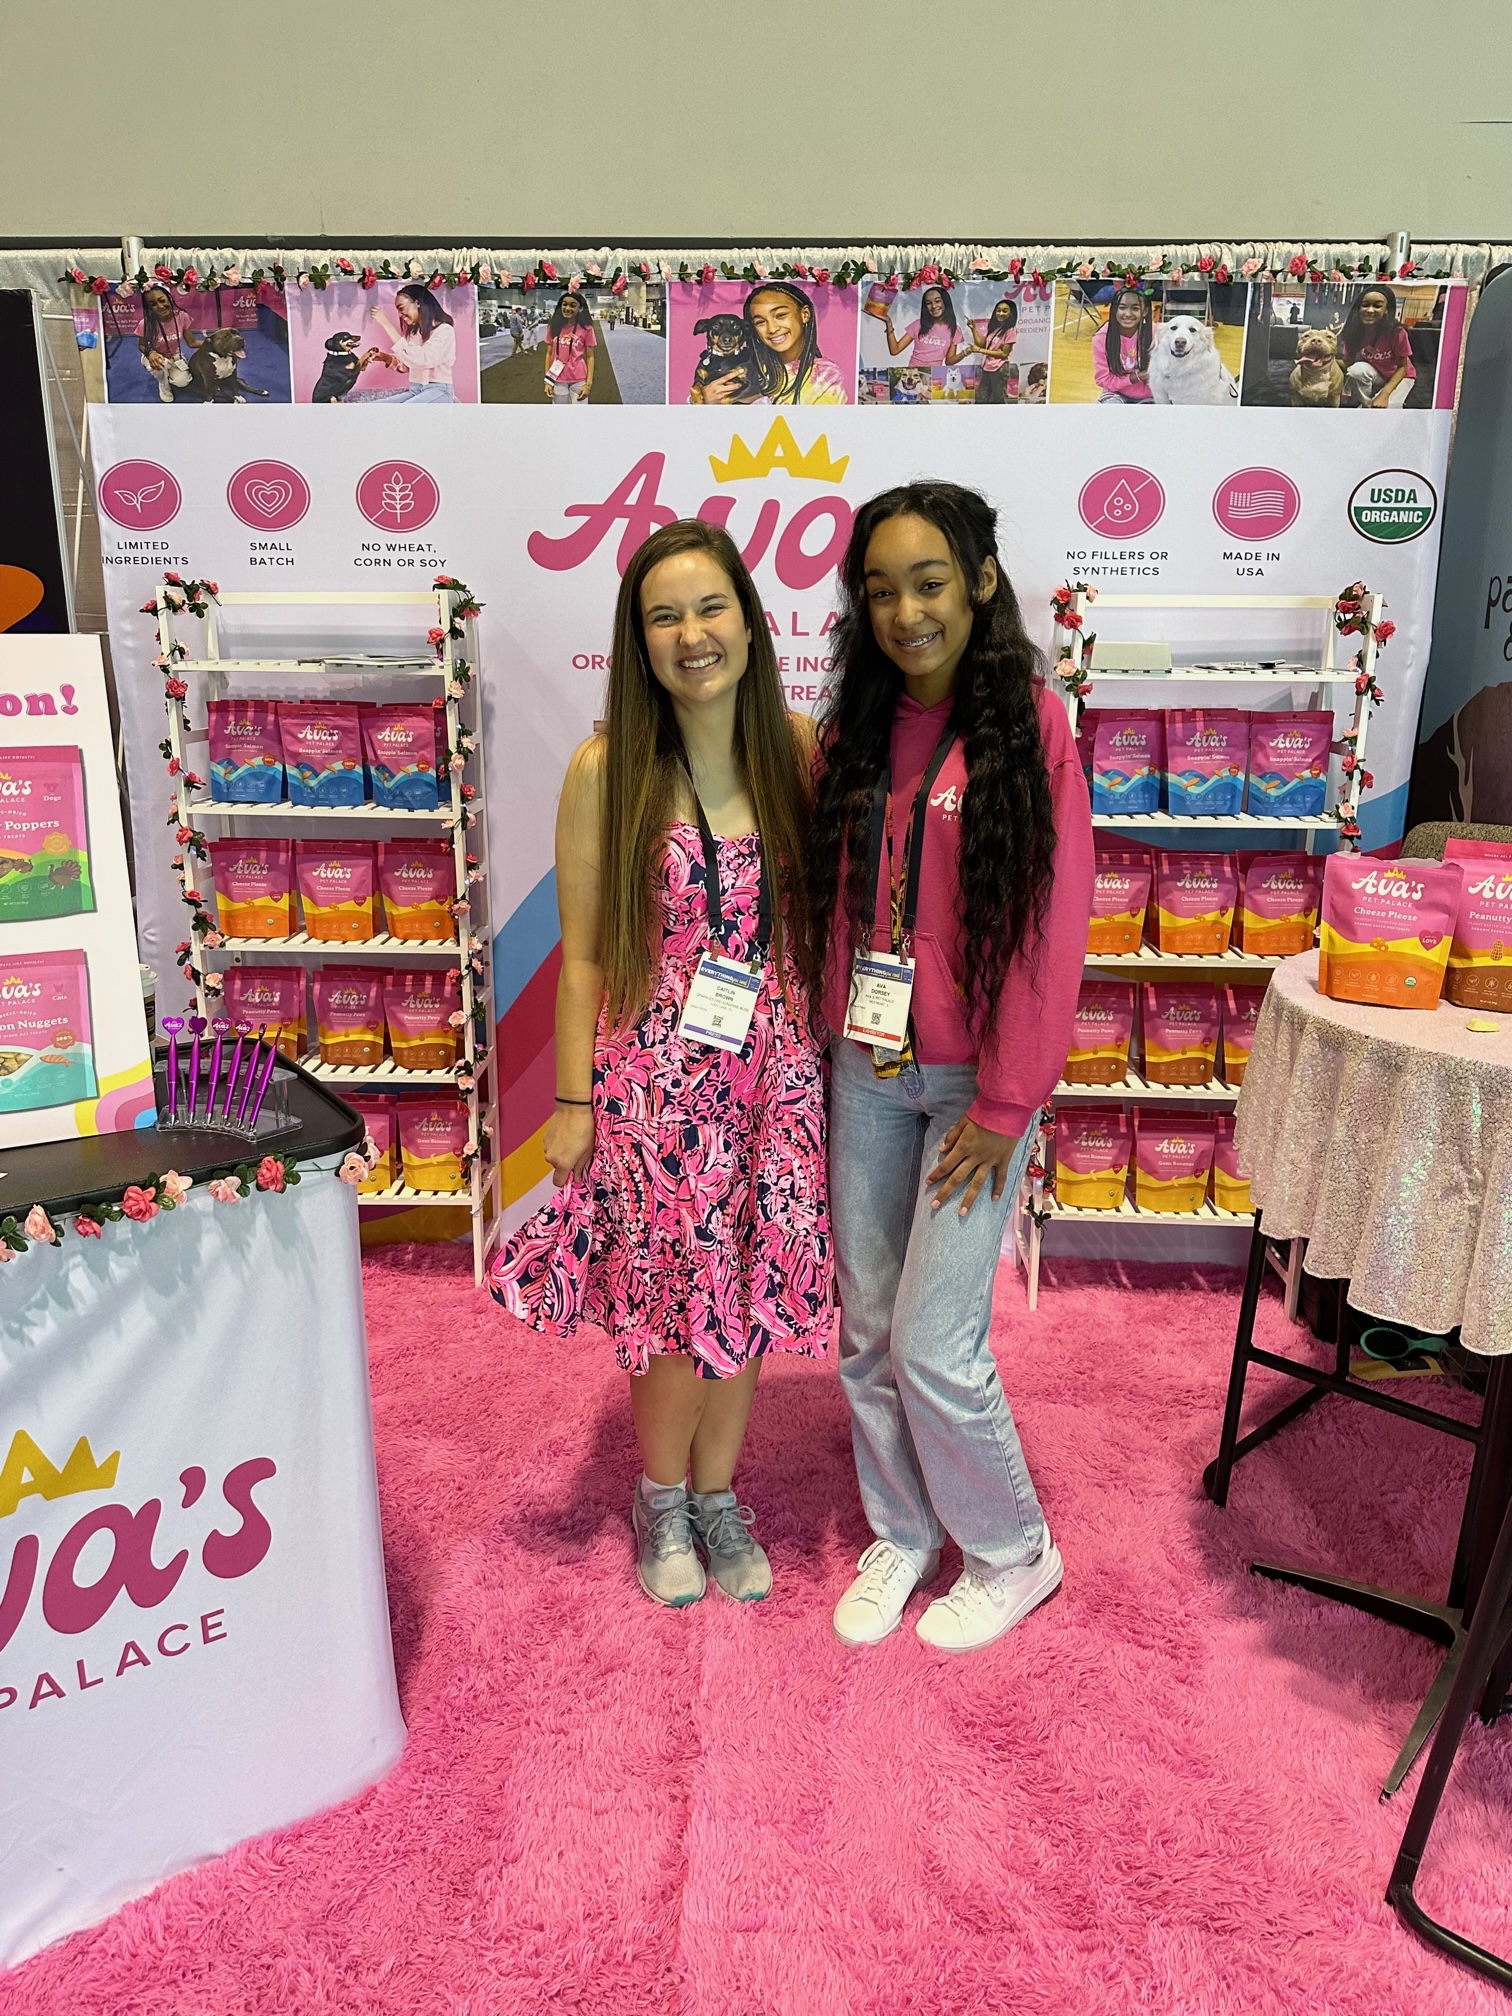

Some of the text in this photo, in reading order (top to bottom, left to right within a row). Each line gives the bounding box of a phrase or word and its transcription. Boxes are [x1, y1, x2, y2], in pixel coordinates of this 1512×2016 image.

[1370, 489, 1418, 504] USDA
[1362, 510, 1422, 523] ORGANIC
[118, 542, 169, 550] LIMITED
[250, 542, 292, 551] SMALL
[362, 543, 436, 553] NO WHEAT,
[250, 557, 294, 566] BATCH
[354, 558, 447, 567] CORN OR SOY
[1066, 551, 1168, 560] NO FILLERS OR
[1223, 552, 1280, 561] MADE IN
[1073, 566, 1160, 576] SYNTHETICS
[1236, 568, 1264, 576] USA
[224, 721, 262, 735] Ava's
[298, 725, 339, 740] Ava's
[377, 727, 414, 742] Ava's
[1109, 731, 1147, 746] Ava's
[1186, 732, 1227, 747] Ava's
[1270, 733, 1312, 749] Ava's
[4, 821, 60, 831] Poppers
[229, 860, 269, 874] Ava's
[312, 861, 351, 878] Ava's
[394, 860, 433, 878] Ava's
[1177, 873, 1218, 889] Ava's
[1262, 874, 1303, 890] Ava's
[1352, 871, 1425, 900] Ava's
[1381, 899, 1413, 908] PALACE
[1354, 907, 1418, 922] Cheeze Pleeze
[1469, 911, 1512, 924] Peanutty
[701, 967, 734, 980] EVERYTHING
[0, 983, 41, 999] va's
[240, 989, 280, 1002] Ava's
[716, 993, 733, 1001] BROWN
[717, 986, 735, 995] CAITLIN
[328, 991, 367, 1005] Ava's
[402, 994, 441, 1008] Ava's
[1076, 1007, 1114, 1021] Ava's
[1162, 1007, 1201, 1021] Ava's
[18, 1017, 68, 1029] Nuggets
[415, 1118, 452, 1132] Ava's
[1073, 1132, 1113, 1148] Ava's
[1155, 1139, 1195, 1154] Ava's
